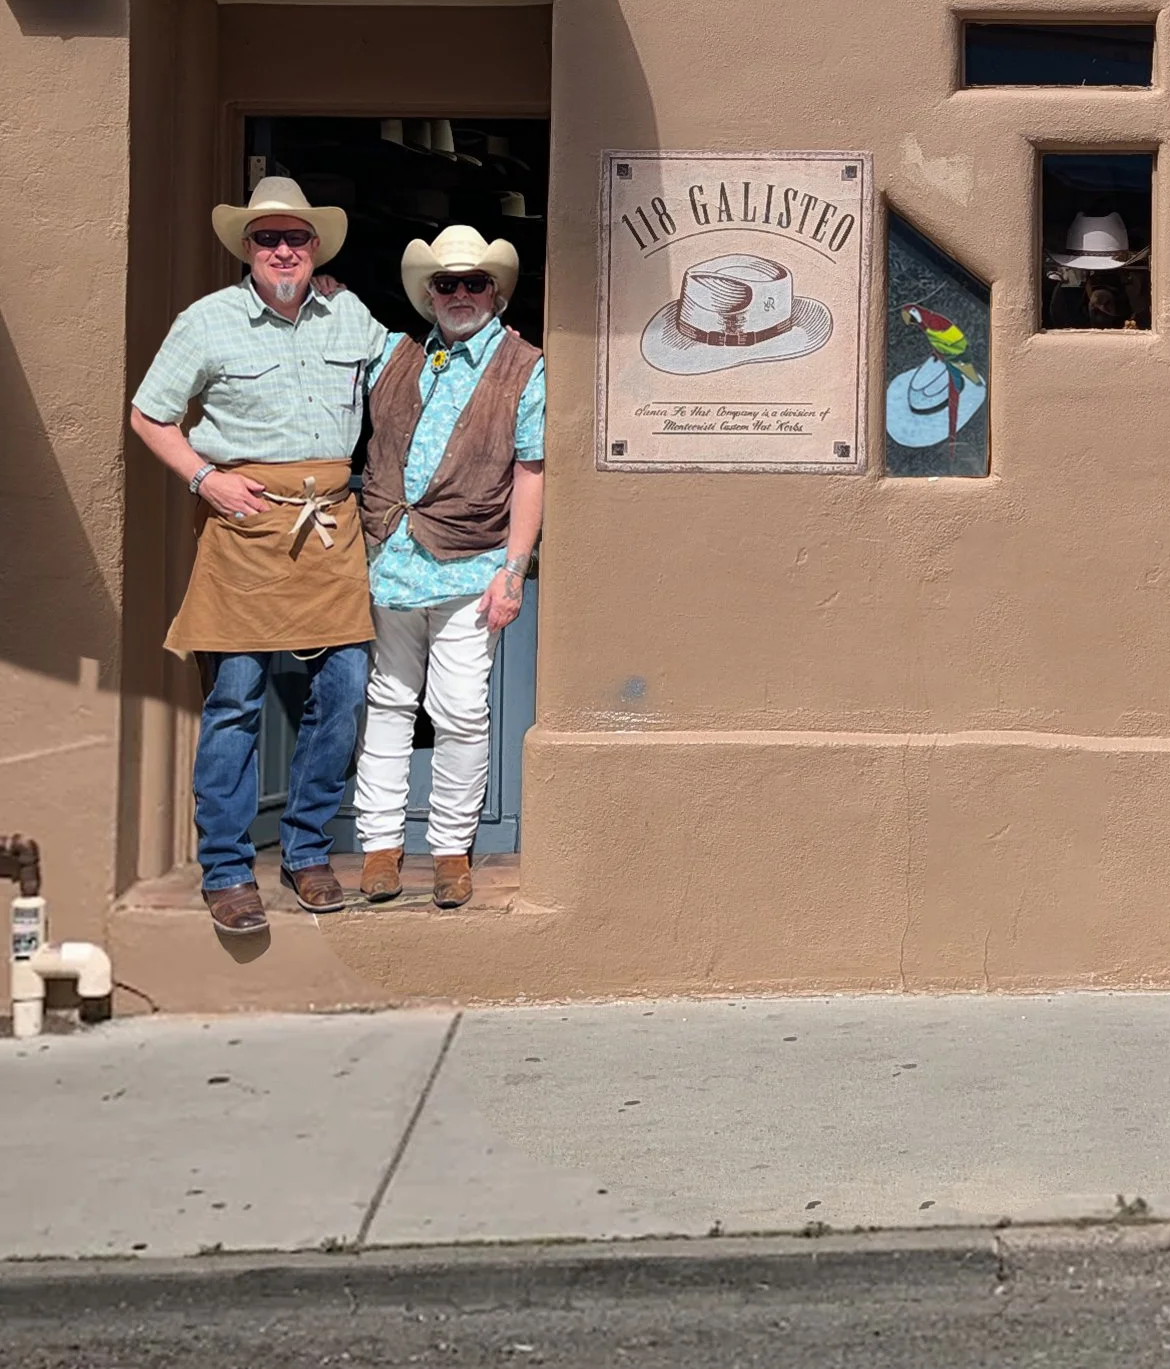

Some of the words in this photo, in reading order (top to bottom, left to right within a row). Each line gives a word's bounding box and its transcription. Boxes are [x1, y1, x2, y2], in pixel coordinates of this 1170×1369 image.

[621, 196, 677, 251] 118
[689, 181, 856, 252] GALISTEO
[634, 404, 667, 417] Santa
[671, 406, 687, 417] Fe
[690, 406, 711, 417] Hat
[716, 405, 759, 420] Company
[761, 408, 769, 417] is
[780, 408, 816, 417] division
[819, 407, 831, 421] of
[663, 418, 716, 431] Montecristi
[719, 420, 749, 431] Custom
[752, 419, 772, 431] Hat
